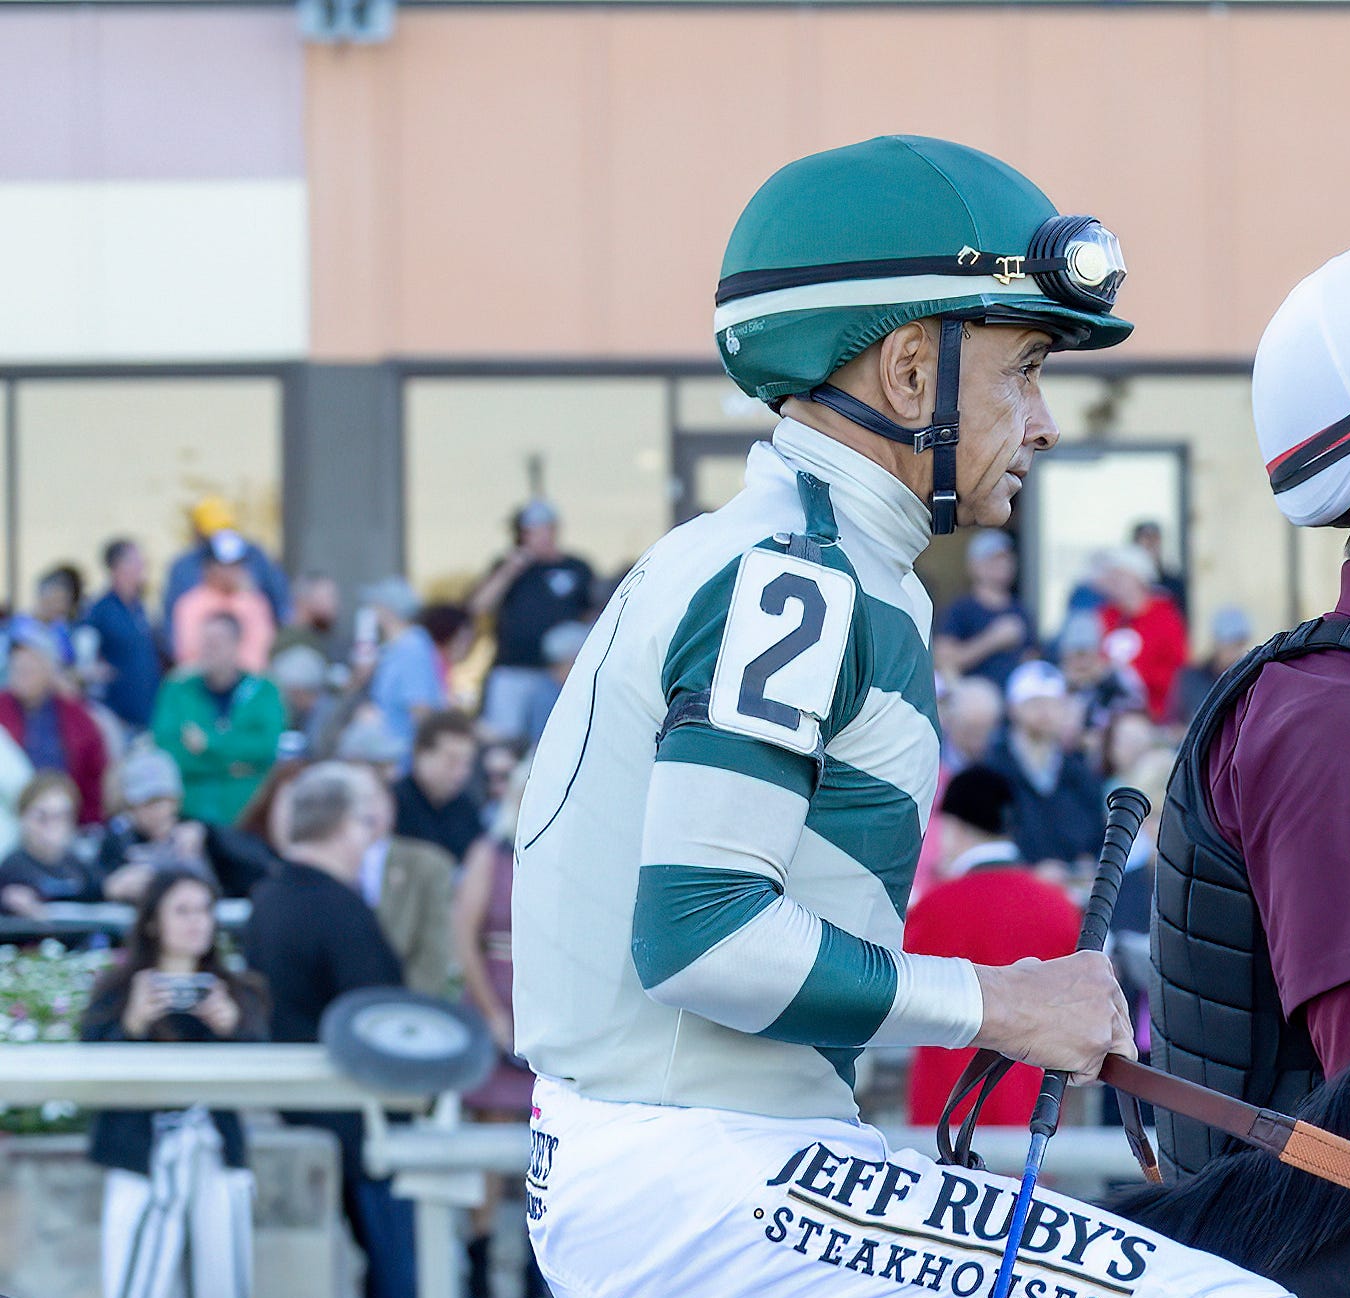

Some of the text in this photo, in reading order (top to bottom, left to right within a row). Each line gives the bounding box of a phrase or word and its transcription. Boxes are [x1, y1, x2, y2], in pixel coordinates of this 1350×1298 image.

[737, 572, 828, 732] 2
[767, 1142, 1157, 1283] JEFF RUBY'S
